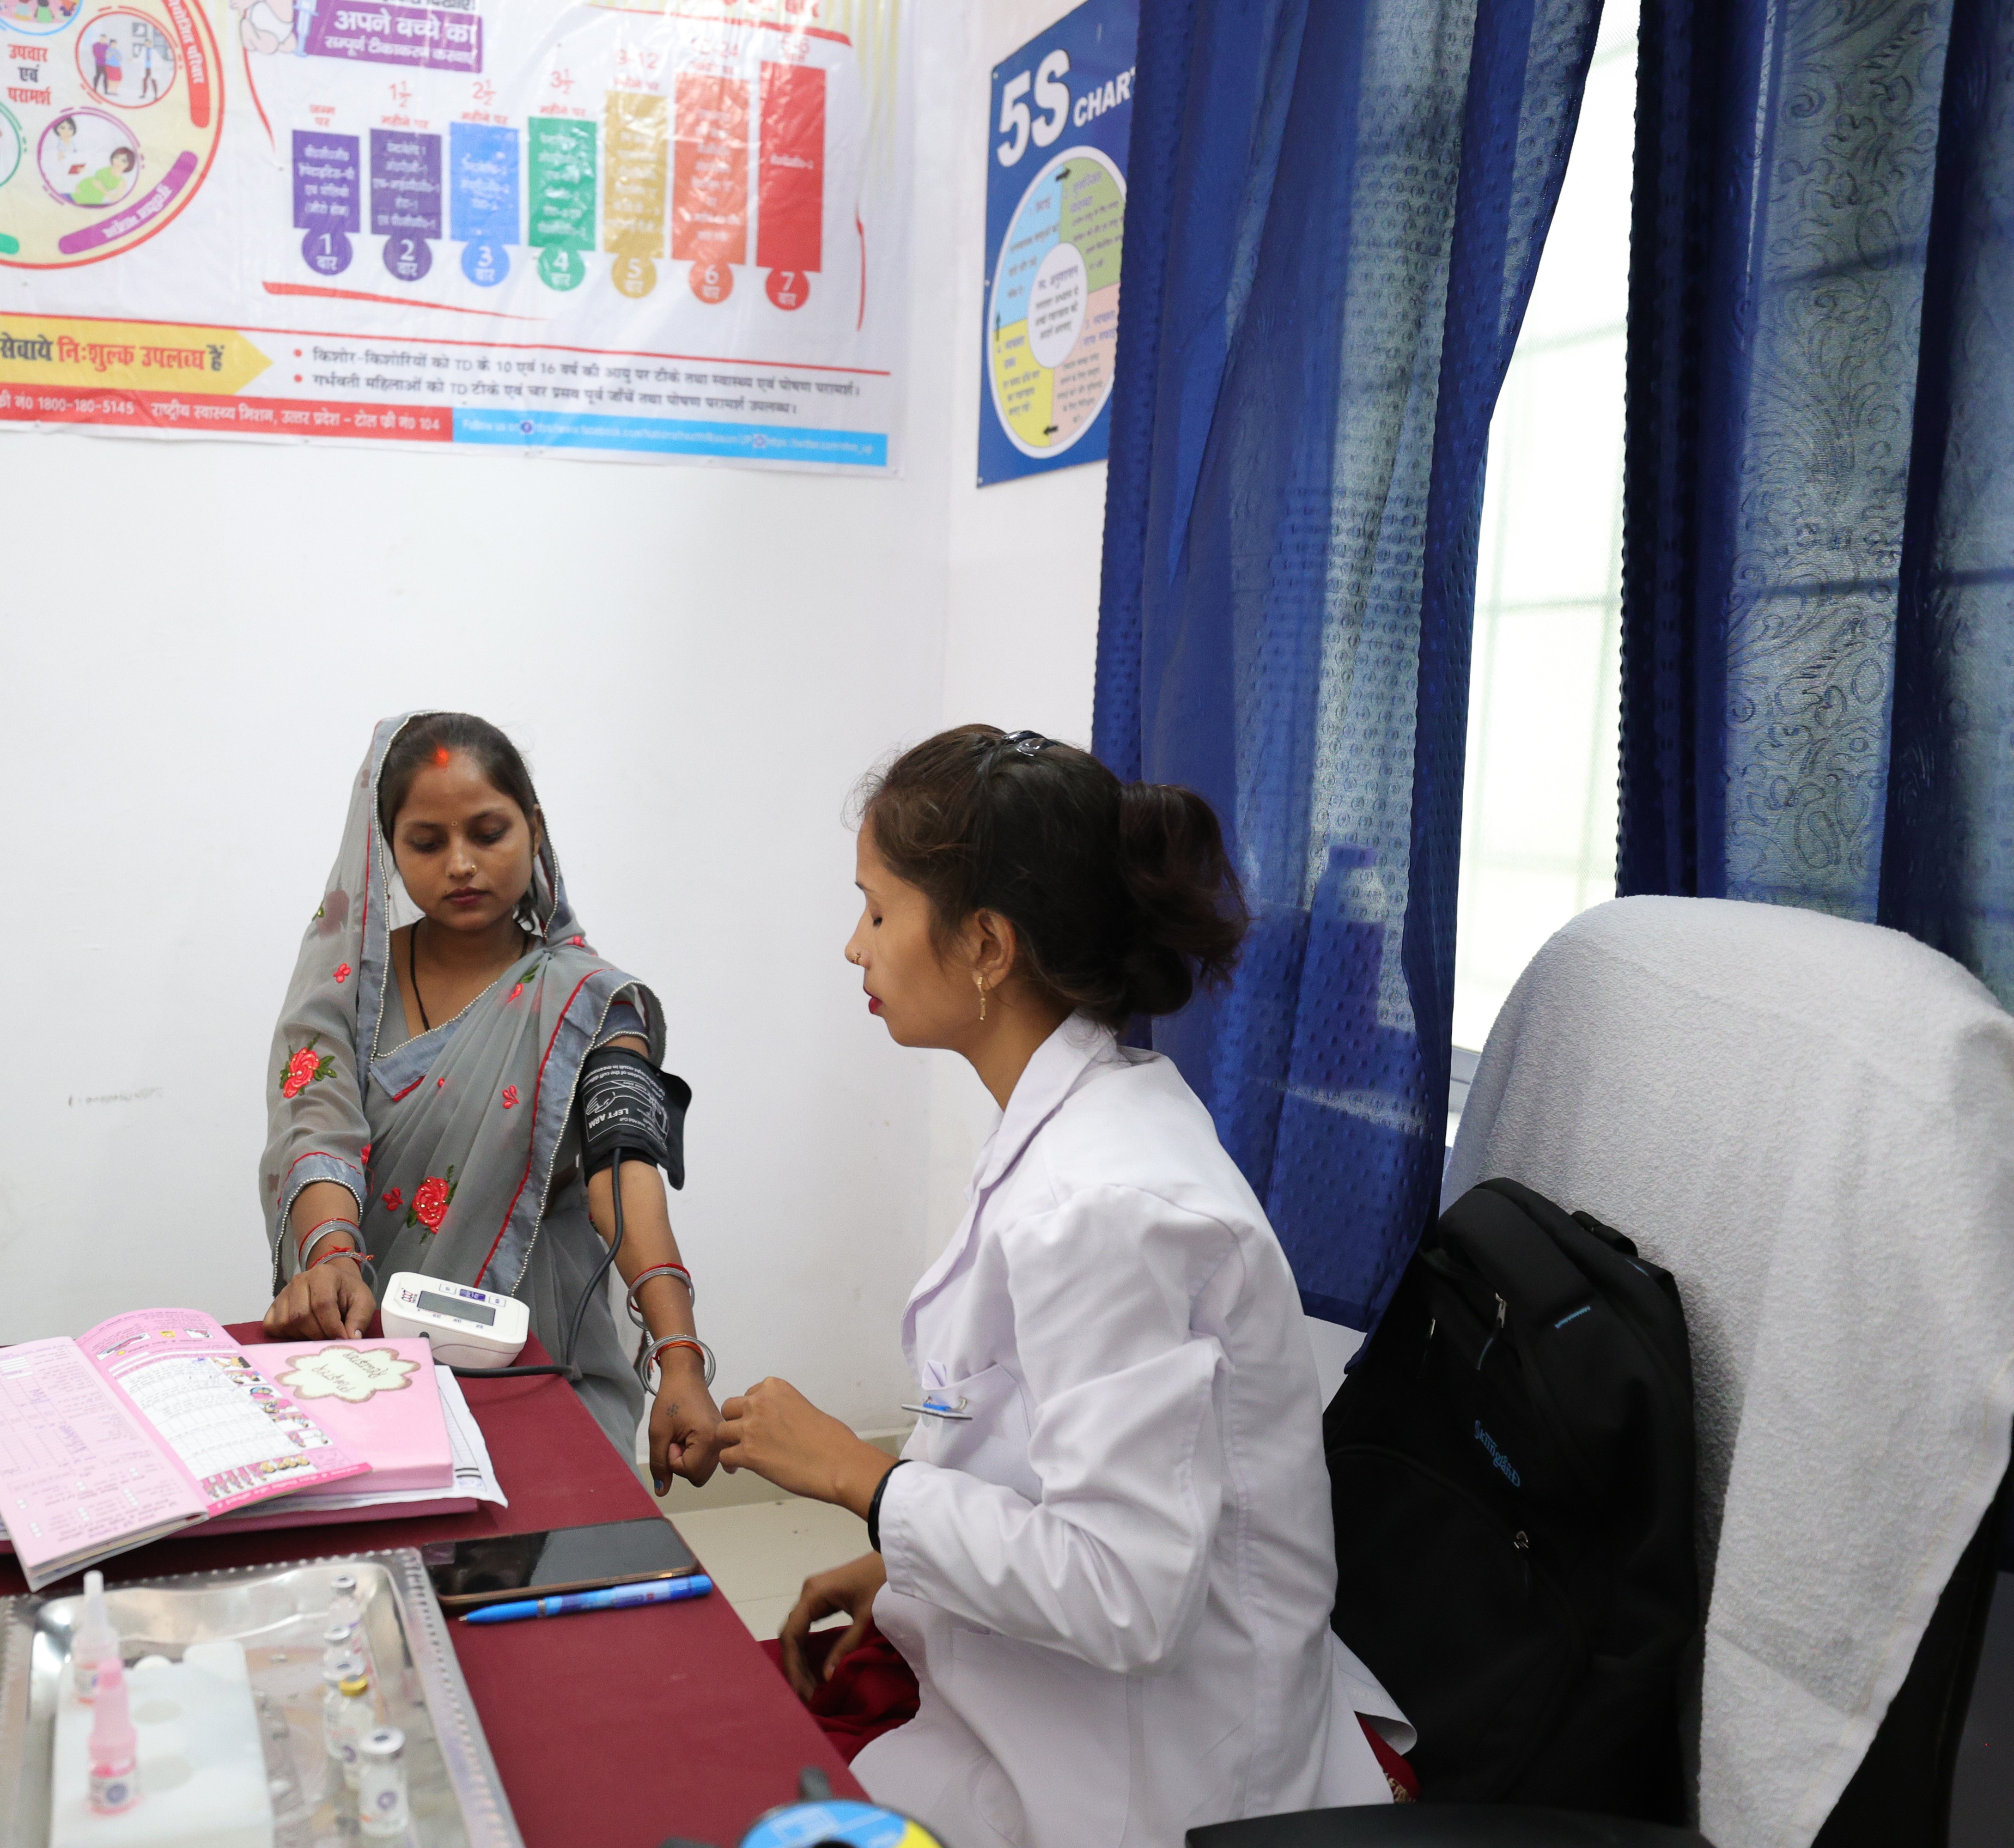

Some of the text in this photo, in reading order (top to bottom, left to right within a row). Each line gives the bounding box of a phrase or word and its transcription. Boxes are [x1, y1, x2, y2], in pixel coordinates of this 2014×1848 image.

[334, 7, 391, 35] अपने
[444, 23, 478, 44] का
[8, 44, 48, 62] उपचार
[18, 64, 39, 83] एवं
[7, 86, 52, 106] परामर्श
[996, 49, 1137, 167] 5S CHAR
[318, 233, 332, 254] 1
[401, 240, 414, 261] 2
[480, 246, 493, 267] 3
[553, 252, 569, 272] 4
[628, 259, 641, 280] 5
[705, 264, 719, 285] 6
[781, 271, 794, 292] 7
[140, 345, 205, 370] उपलब्ध
[207, 344, 225, 371] हैं
[432, 355, 450, 369] को
[456, 359, 472, 371] TD
[497, 362, 511, 373] 10
[517, 358, 535, 375] एवं
[541, 363, 556, 375] 16
[313, 371, 359, 389] गर्भवती
[365, 376, 421, 392] महिलाओं
[426, 378, 444, 392] को
[450, 383, 468, 395] TD
[472, 380, 499, 395] टीके
[505, 383, 523, 401] एवं
[588, 1107, 629, 1129] LEFT ARM
